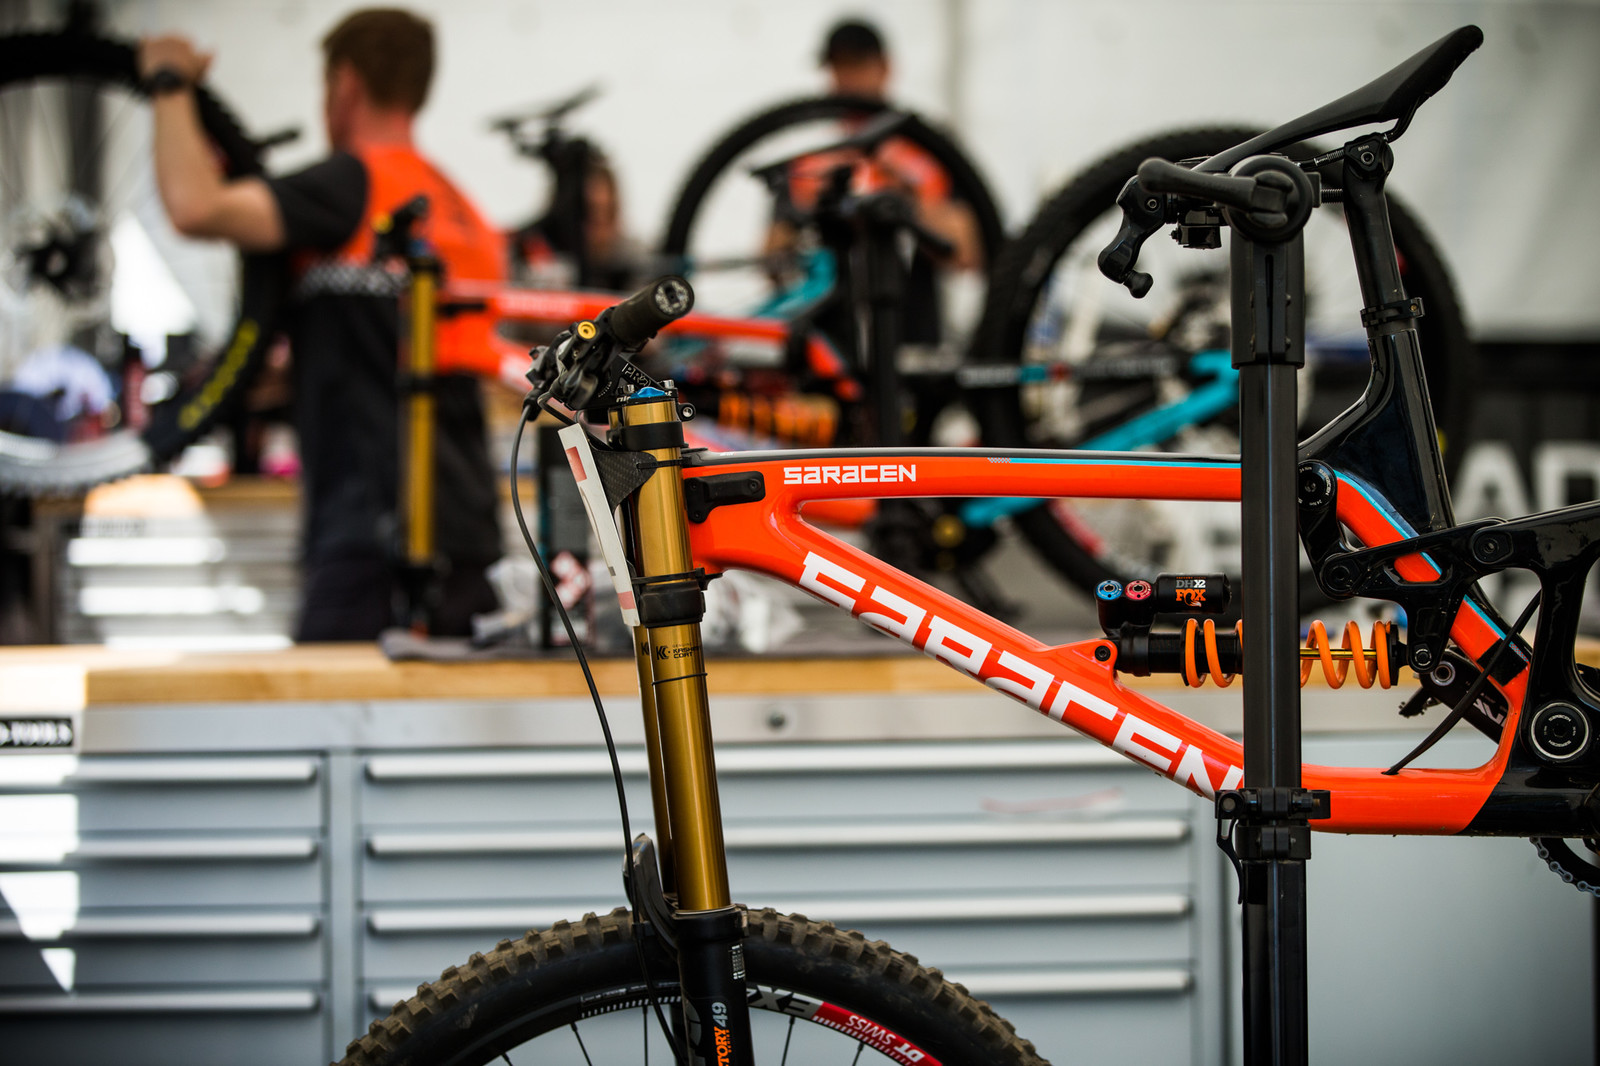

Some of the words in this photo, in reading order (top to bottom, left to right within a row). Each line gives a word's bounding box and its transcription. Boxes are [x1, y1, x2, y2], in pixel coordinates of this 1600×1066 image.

[783, 464, 916, 485] SARACEN
[1175, 588, 1206, 607] FOX
[711, 1001, 728, 1027] 49
[845, 1014, 897, 1046] SWISS
[713, 1026, 730, 1066] TORY
[893, 1042, 926, 1063] DT
